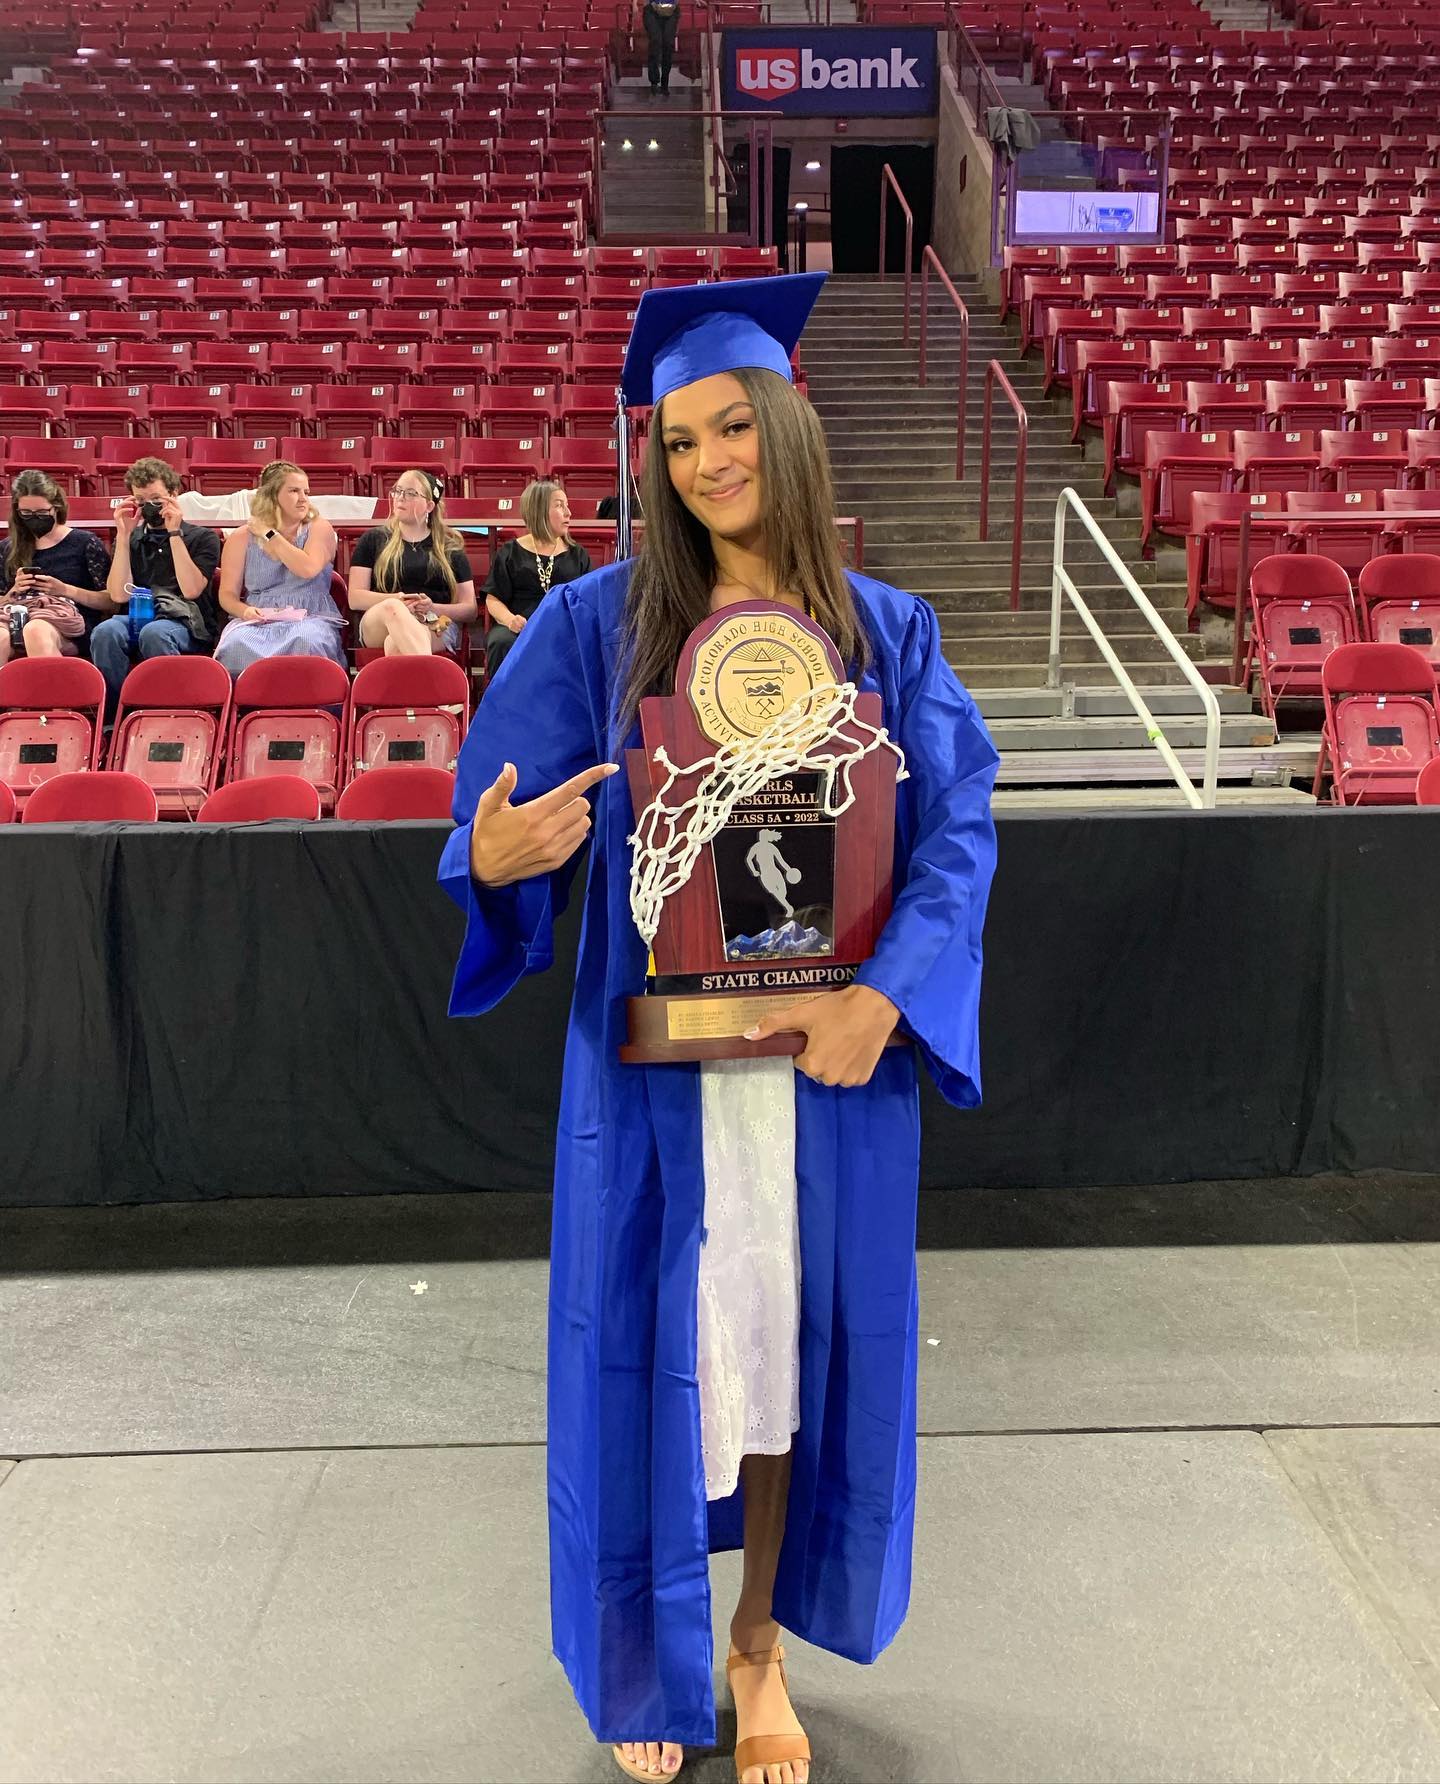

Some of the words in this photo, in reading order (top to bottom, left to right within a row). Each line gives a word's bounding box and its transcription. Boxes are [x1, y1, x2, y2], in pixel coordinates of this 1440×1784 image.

[130, 388, 138, 396] 12
[293, 388, 301, 396] 14
[373, 387, 382, 395] 15
[454, 388, 463, 396] 16
[535, 388, 544, 396] 17
[75, 440, 85, 448] 12
[166, 440, 176, 448] 13
[255, 440, 265, 448] 14
[344, 440, 353, 448] 15
[433, 440, 443, 448] 16
[521, 440, 530, 449] 17
[501, 499, 511, 508] 17
[701, 623, 747, 685] COLORADO
[753, 621, 786, 636] HIGH
[790, 632, 824, 680] SCHOOL
[735, 793, 819, 806] ASKETBALL
[726, 814, 764, 824] CLASS
[767, 814, 782, 824] 5A
[794, 813, 819, 822] 2022
[702, 973, 759, 990] STATE
